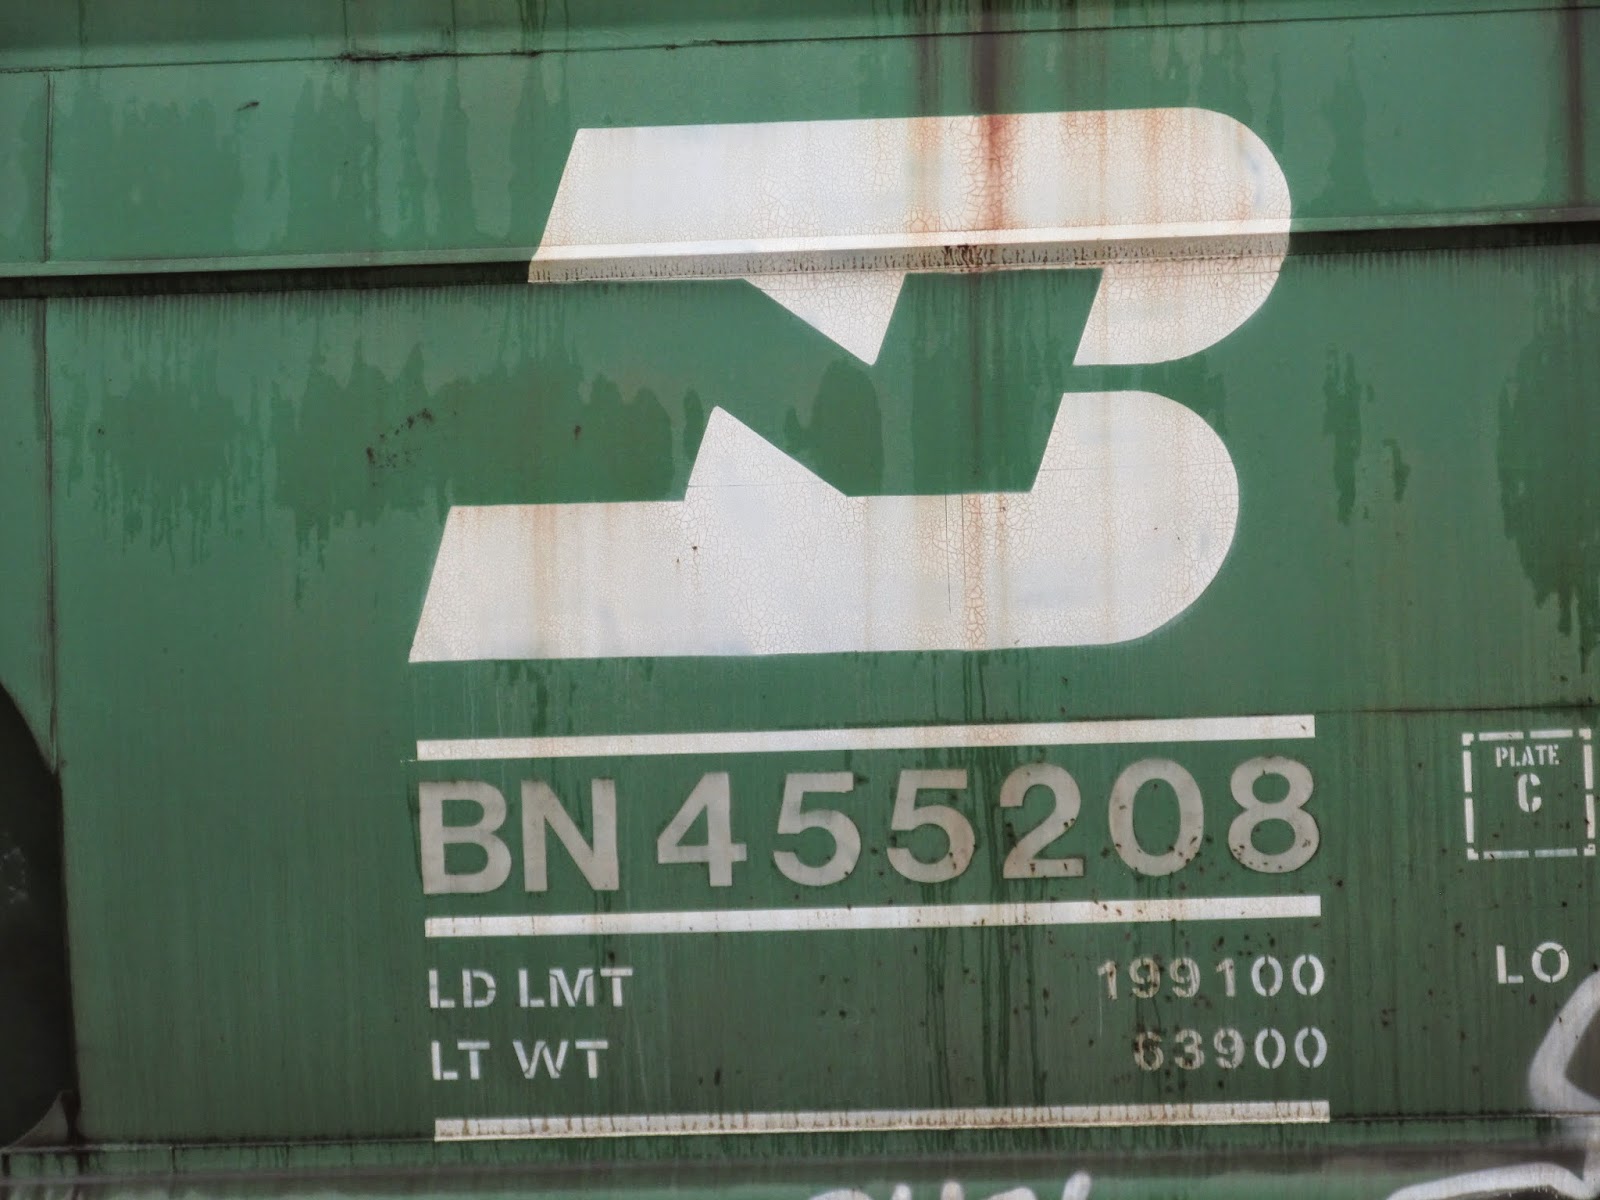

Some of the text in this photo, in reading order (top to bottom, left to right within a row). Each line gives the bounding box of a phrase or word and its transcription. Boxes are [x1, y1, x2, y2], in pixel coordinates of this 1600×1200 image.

[1494, 744, 1561, 767] PLATE
[1517, 773, 1543, 813] C
[418, 755, 1320, 895] BN 455208
[428, 954, 1326, 1009] LD LMT 199100
[1496, 941, 1570, 984] LO
[431, 1026, 1329, 1081] LT WT 63900
